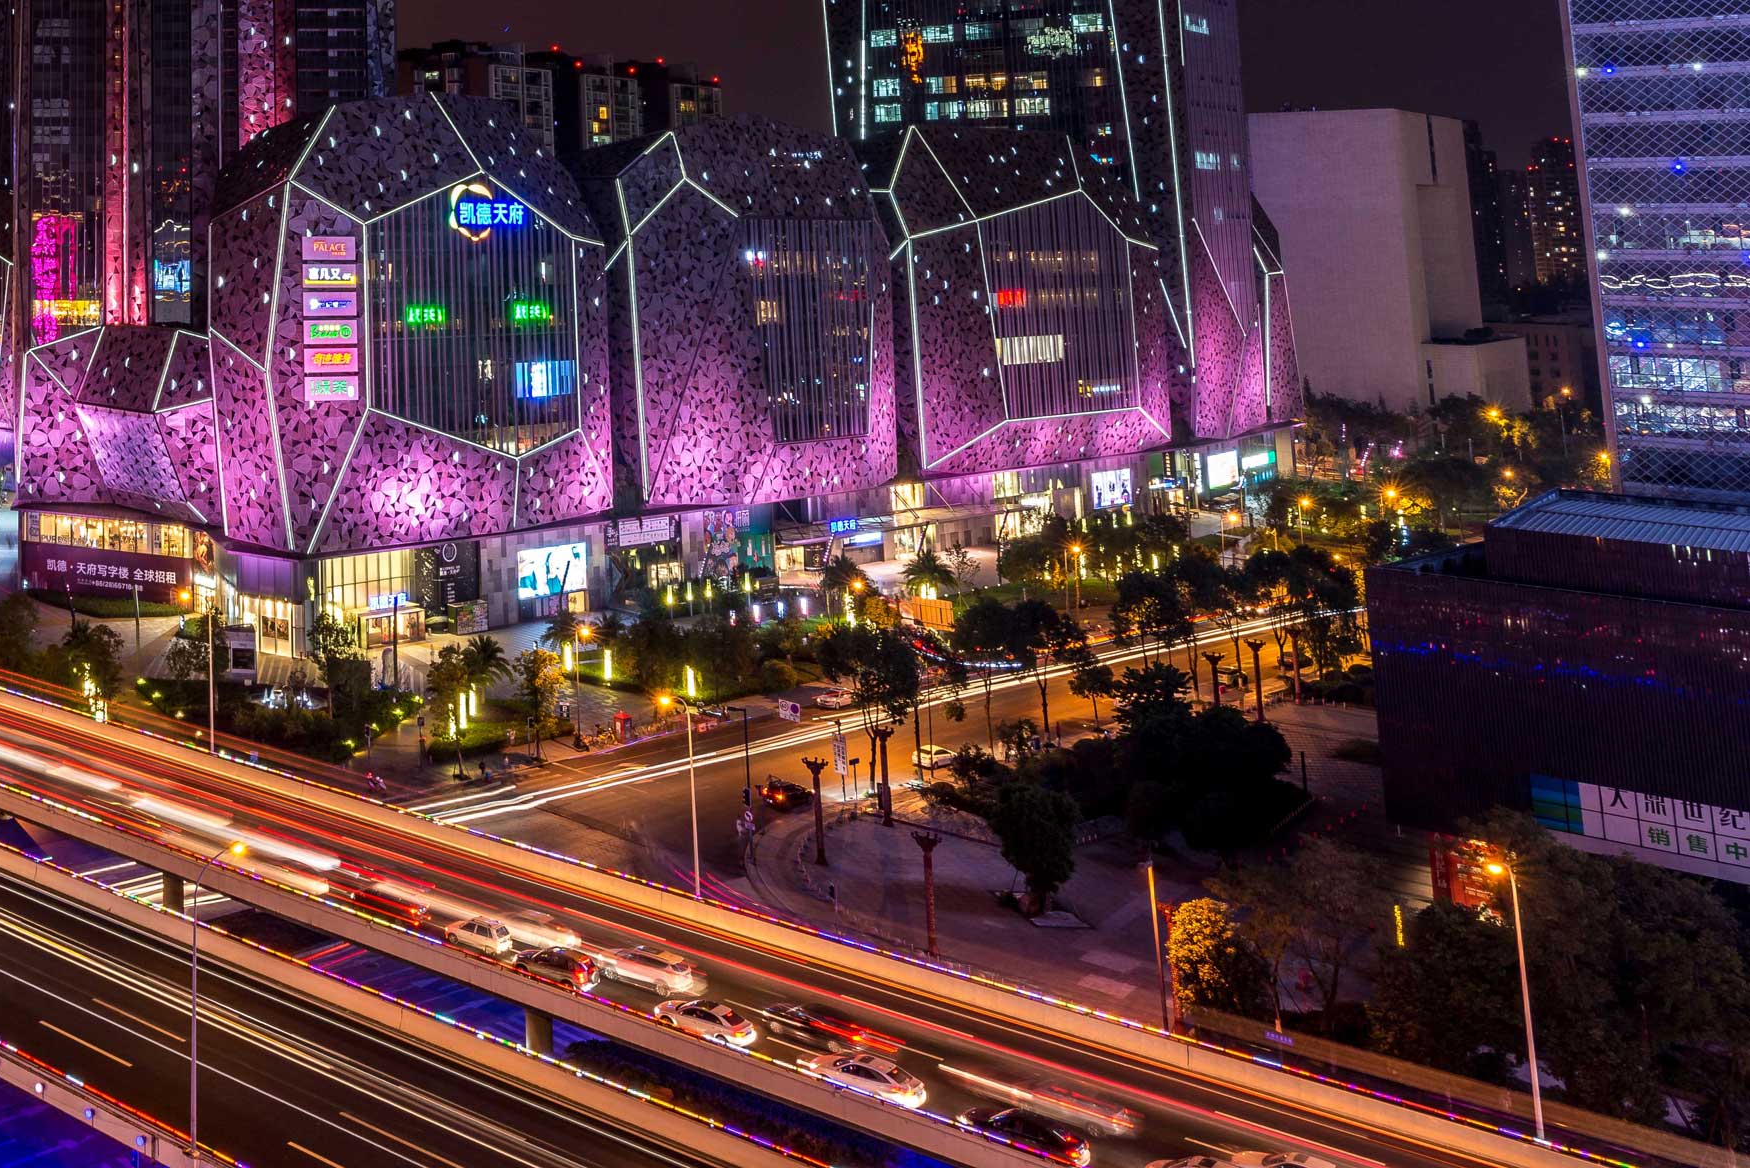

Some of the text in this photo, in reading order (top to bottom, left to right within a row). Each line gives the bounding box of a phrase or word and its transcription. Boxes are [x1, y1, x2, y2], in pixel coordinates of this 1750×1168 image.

[459, 202, 524, 225] 凯德天府
[313, 242, 346, 252] PALACE
[830, 519, 856, 532] 凯德天府
[133, 568, 176, 584] 全球招租
[1647, 826, 1748, 861] 销售中
